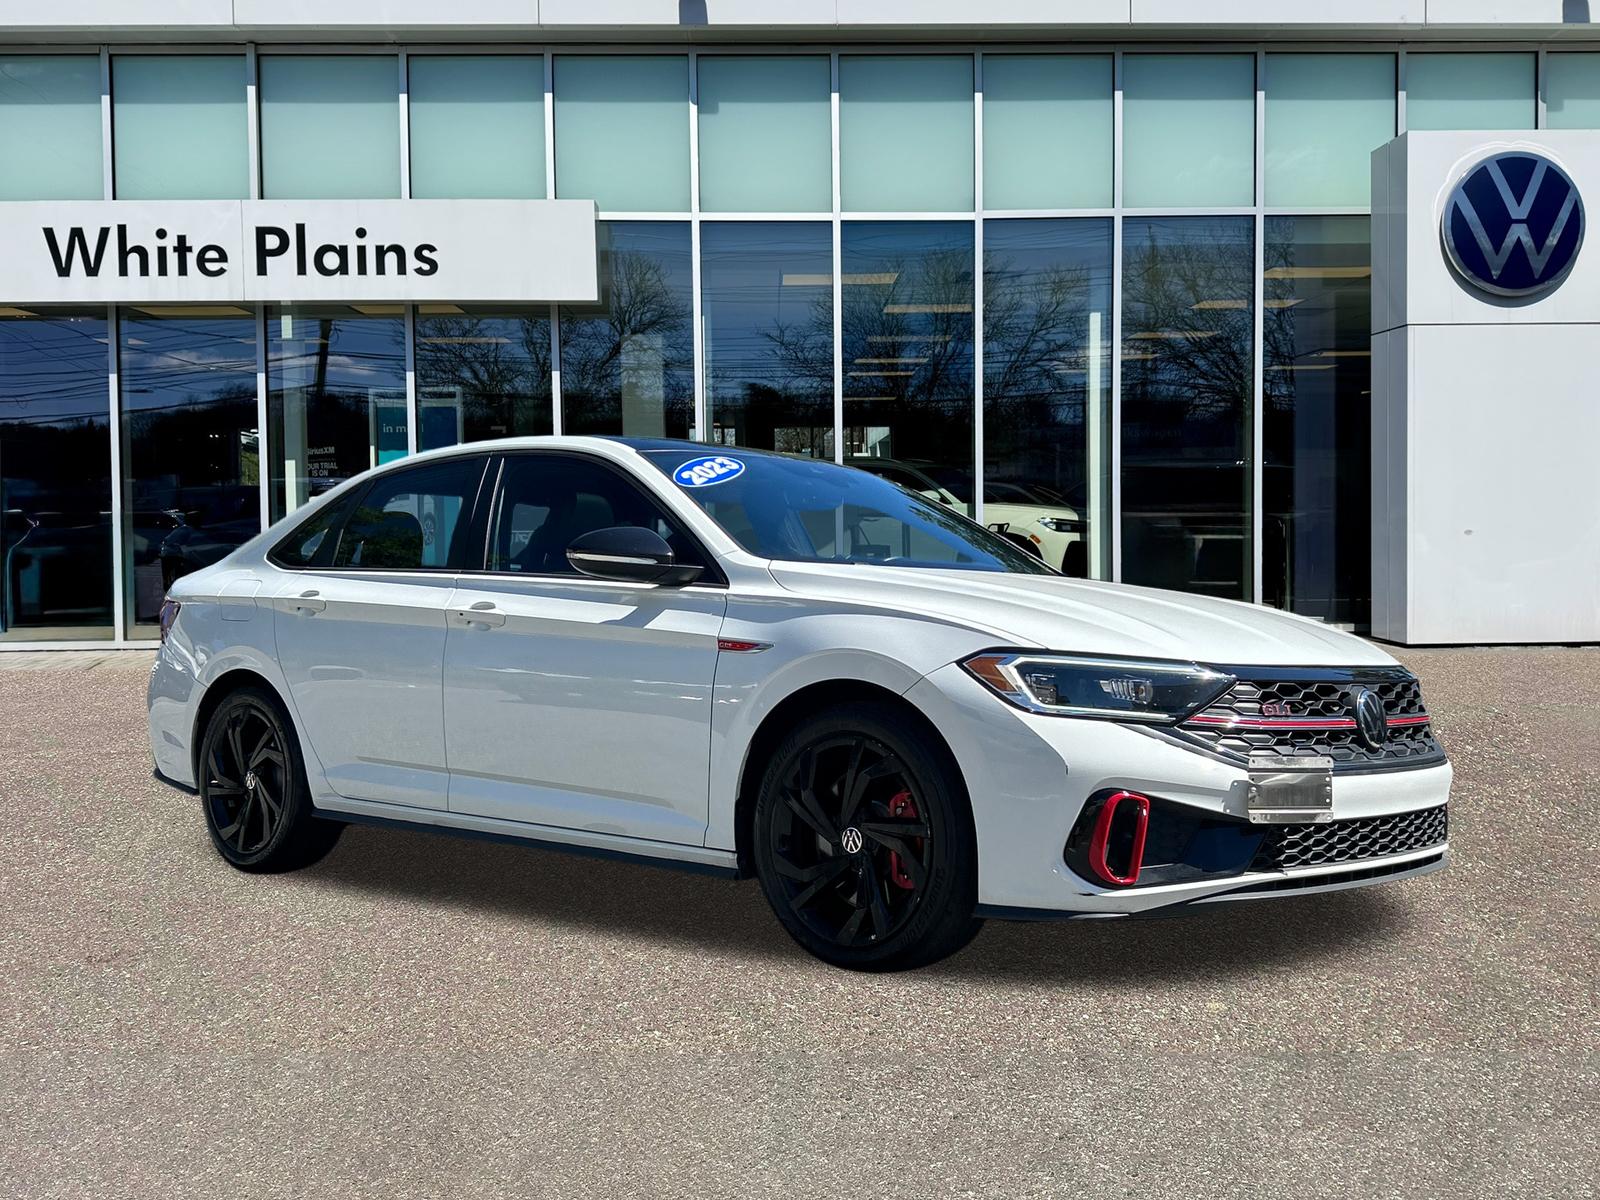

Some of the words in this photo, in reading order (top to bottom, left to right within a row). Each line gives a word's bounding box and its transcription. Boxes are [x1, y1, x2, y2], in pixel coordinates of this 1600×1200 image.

[42, 223, 229, 278] White
[254, 222, 439, 277] Plains
[383, 424, 393, 433] in
[304, 463, 320, 471] OUR
[320, 462, 338, 470] TRIAL
[680, 456, 740, 485] 2023
[319, 469, 329, 477] ON
